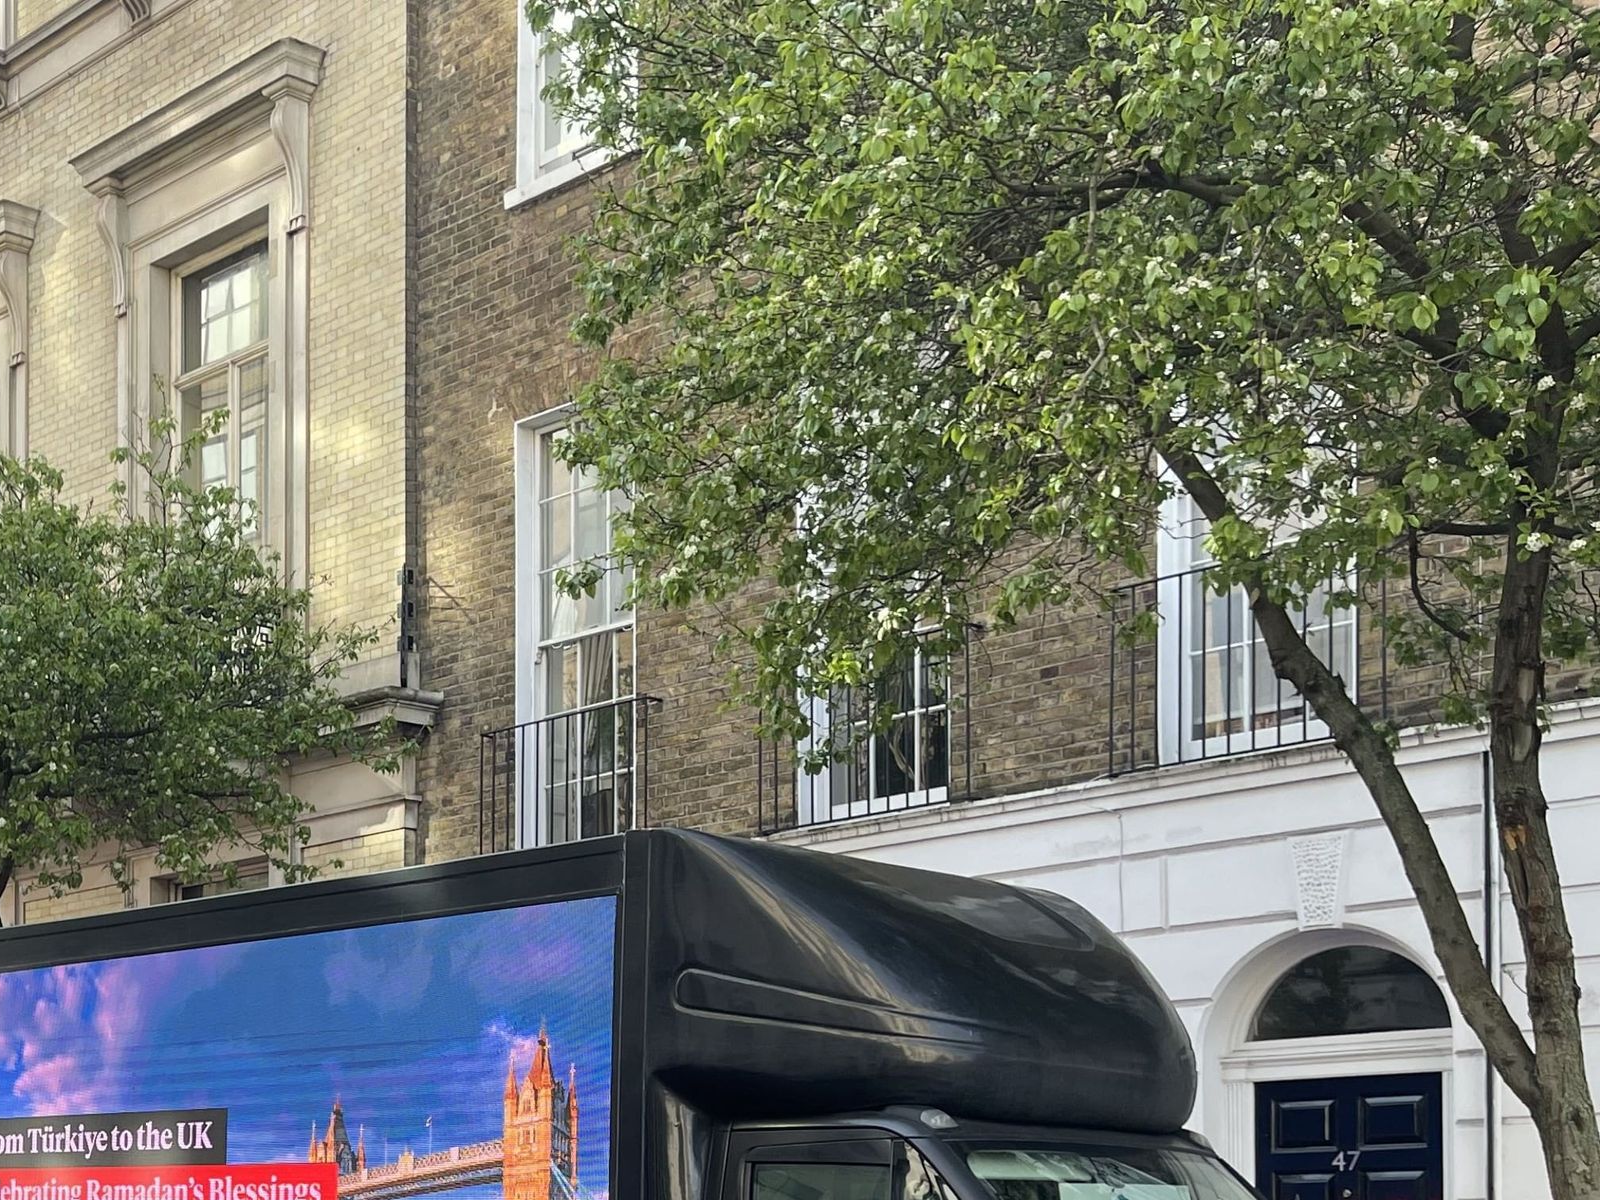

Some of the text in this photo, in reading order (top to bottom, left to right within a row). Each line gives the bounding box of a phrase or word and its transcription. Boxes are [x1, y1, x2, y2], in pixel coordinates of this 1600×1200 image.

[27, 1123, 108, 1159] Türkiye
[111, 1125, 132, 1151] to
[136, 1121, 173, 1151] the
[176, 1121, 213, 1150] UK
[1331, 1150, 1361, 1172] 47
